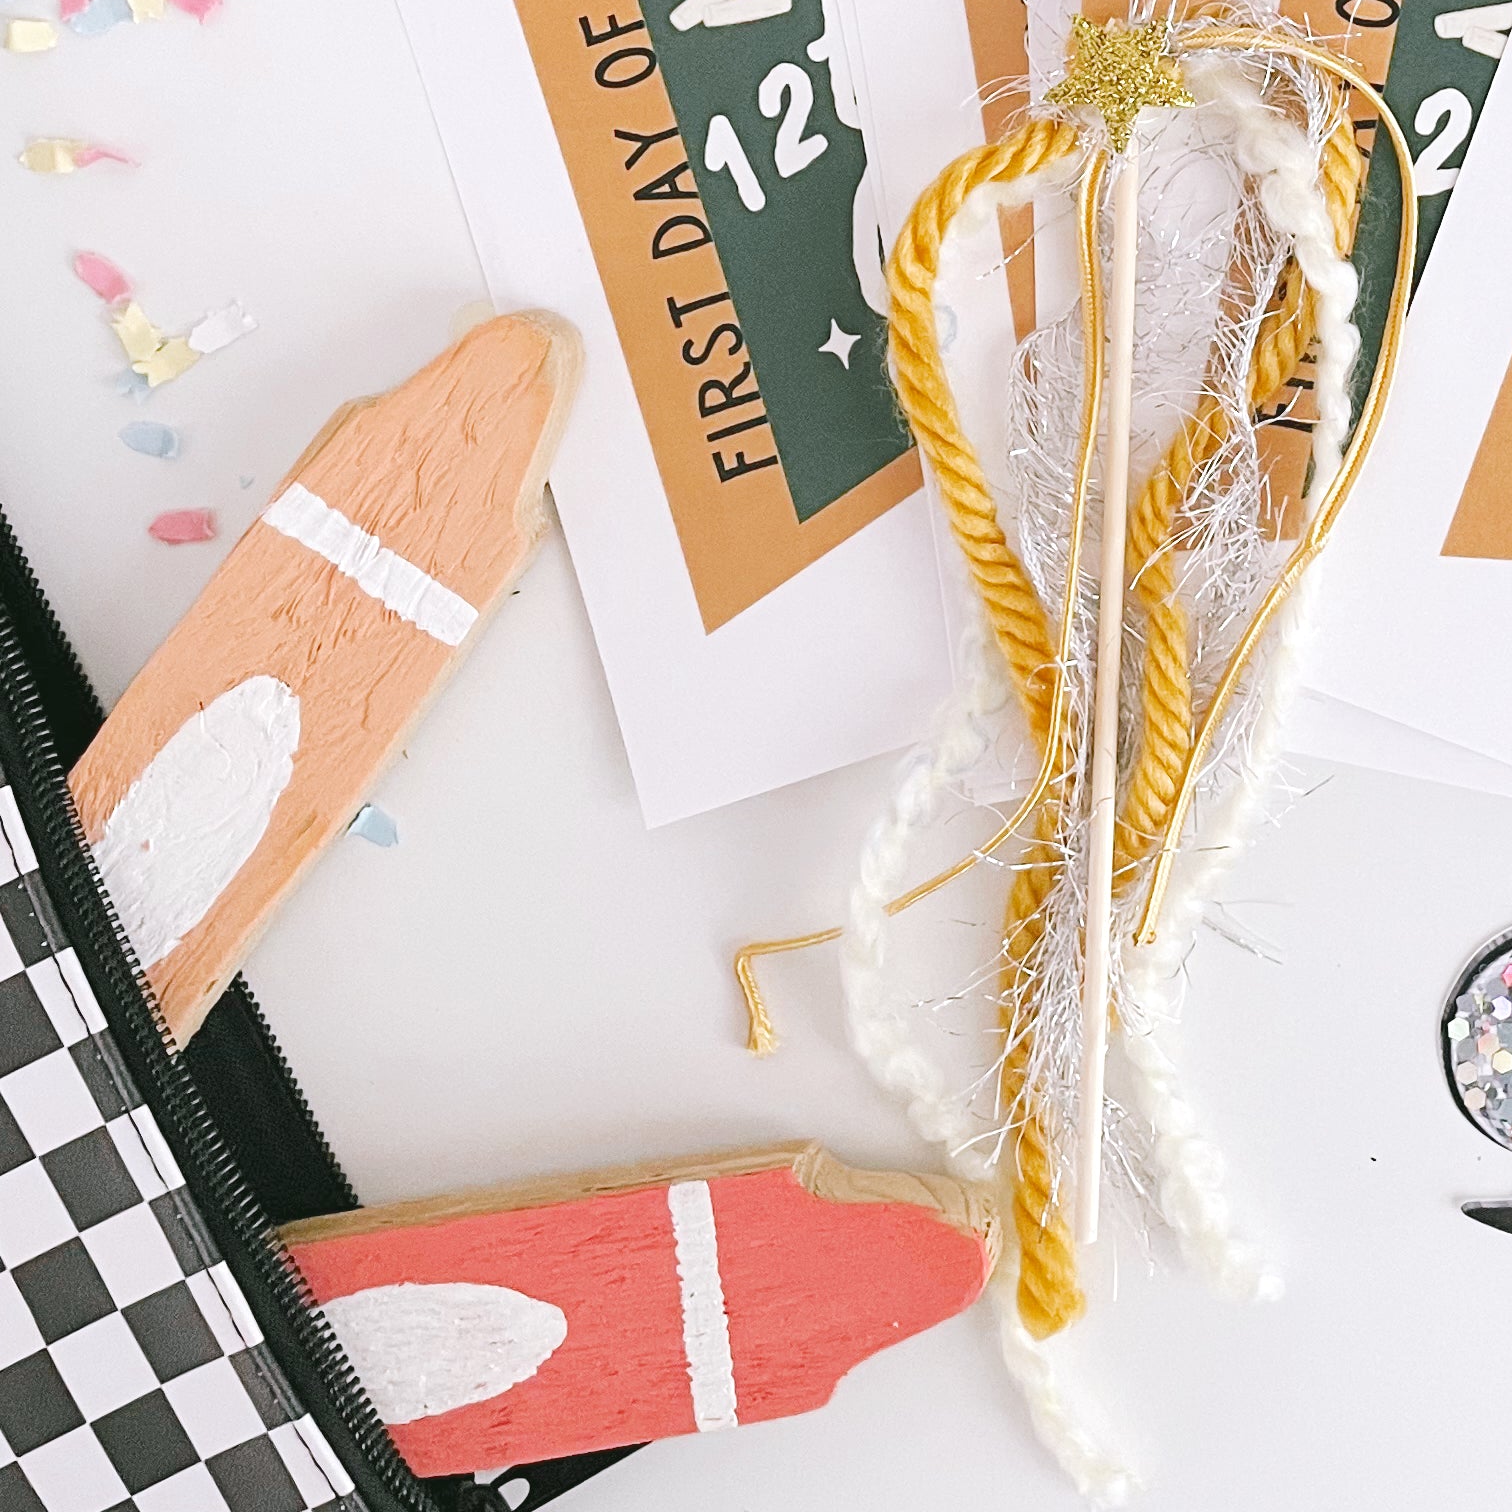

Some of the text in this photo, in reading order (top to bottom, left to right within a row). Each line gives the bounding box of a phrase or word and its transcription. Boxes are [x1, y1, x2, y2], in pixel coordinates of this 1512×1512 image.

[578, 13, 780, 484] FIRST DAY OF
